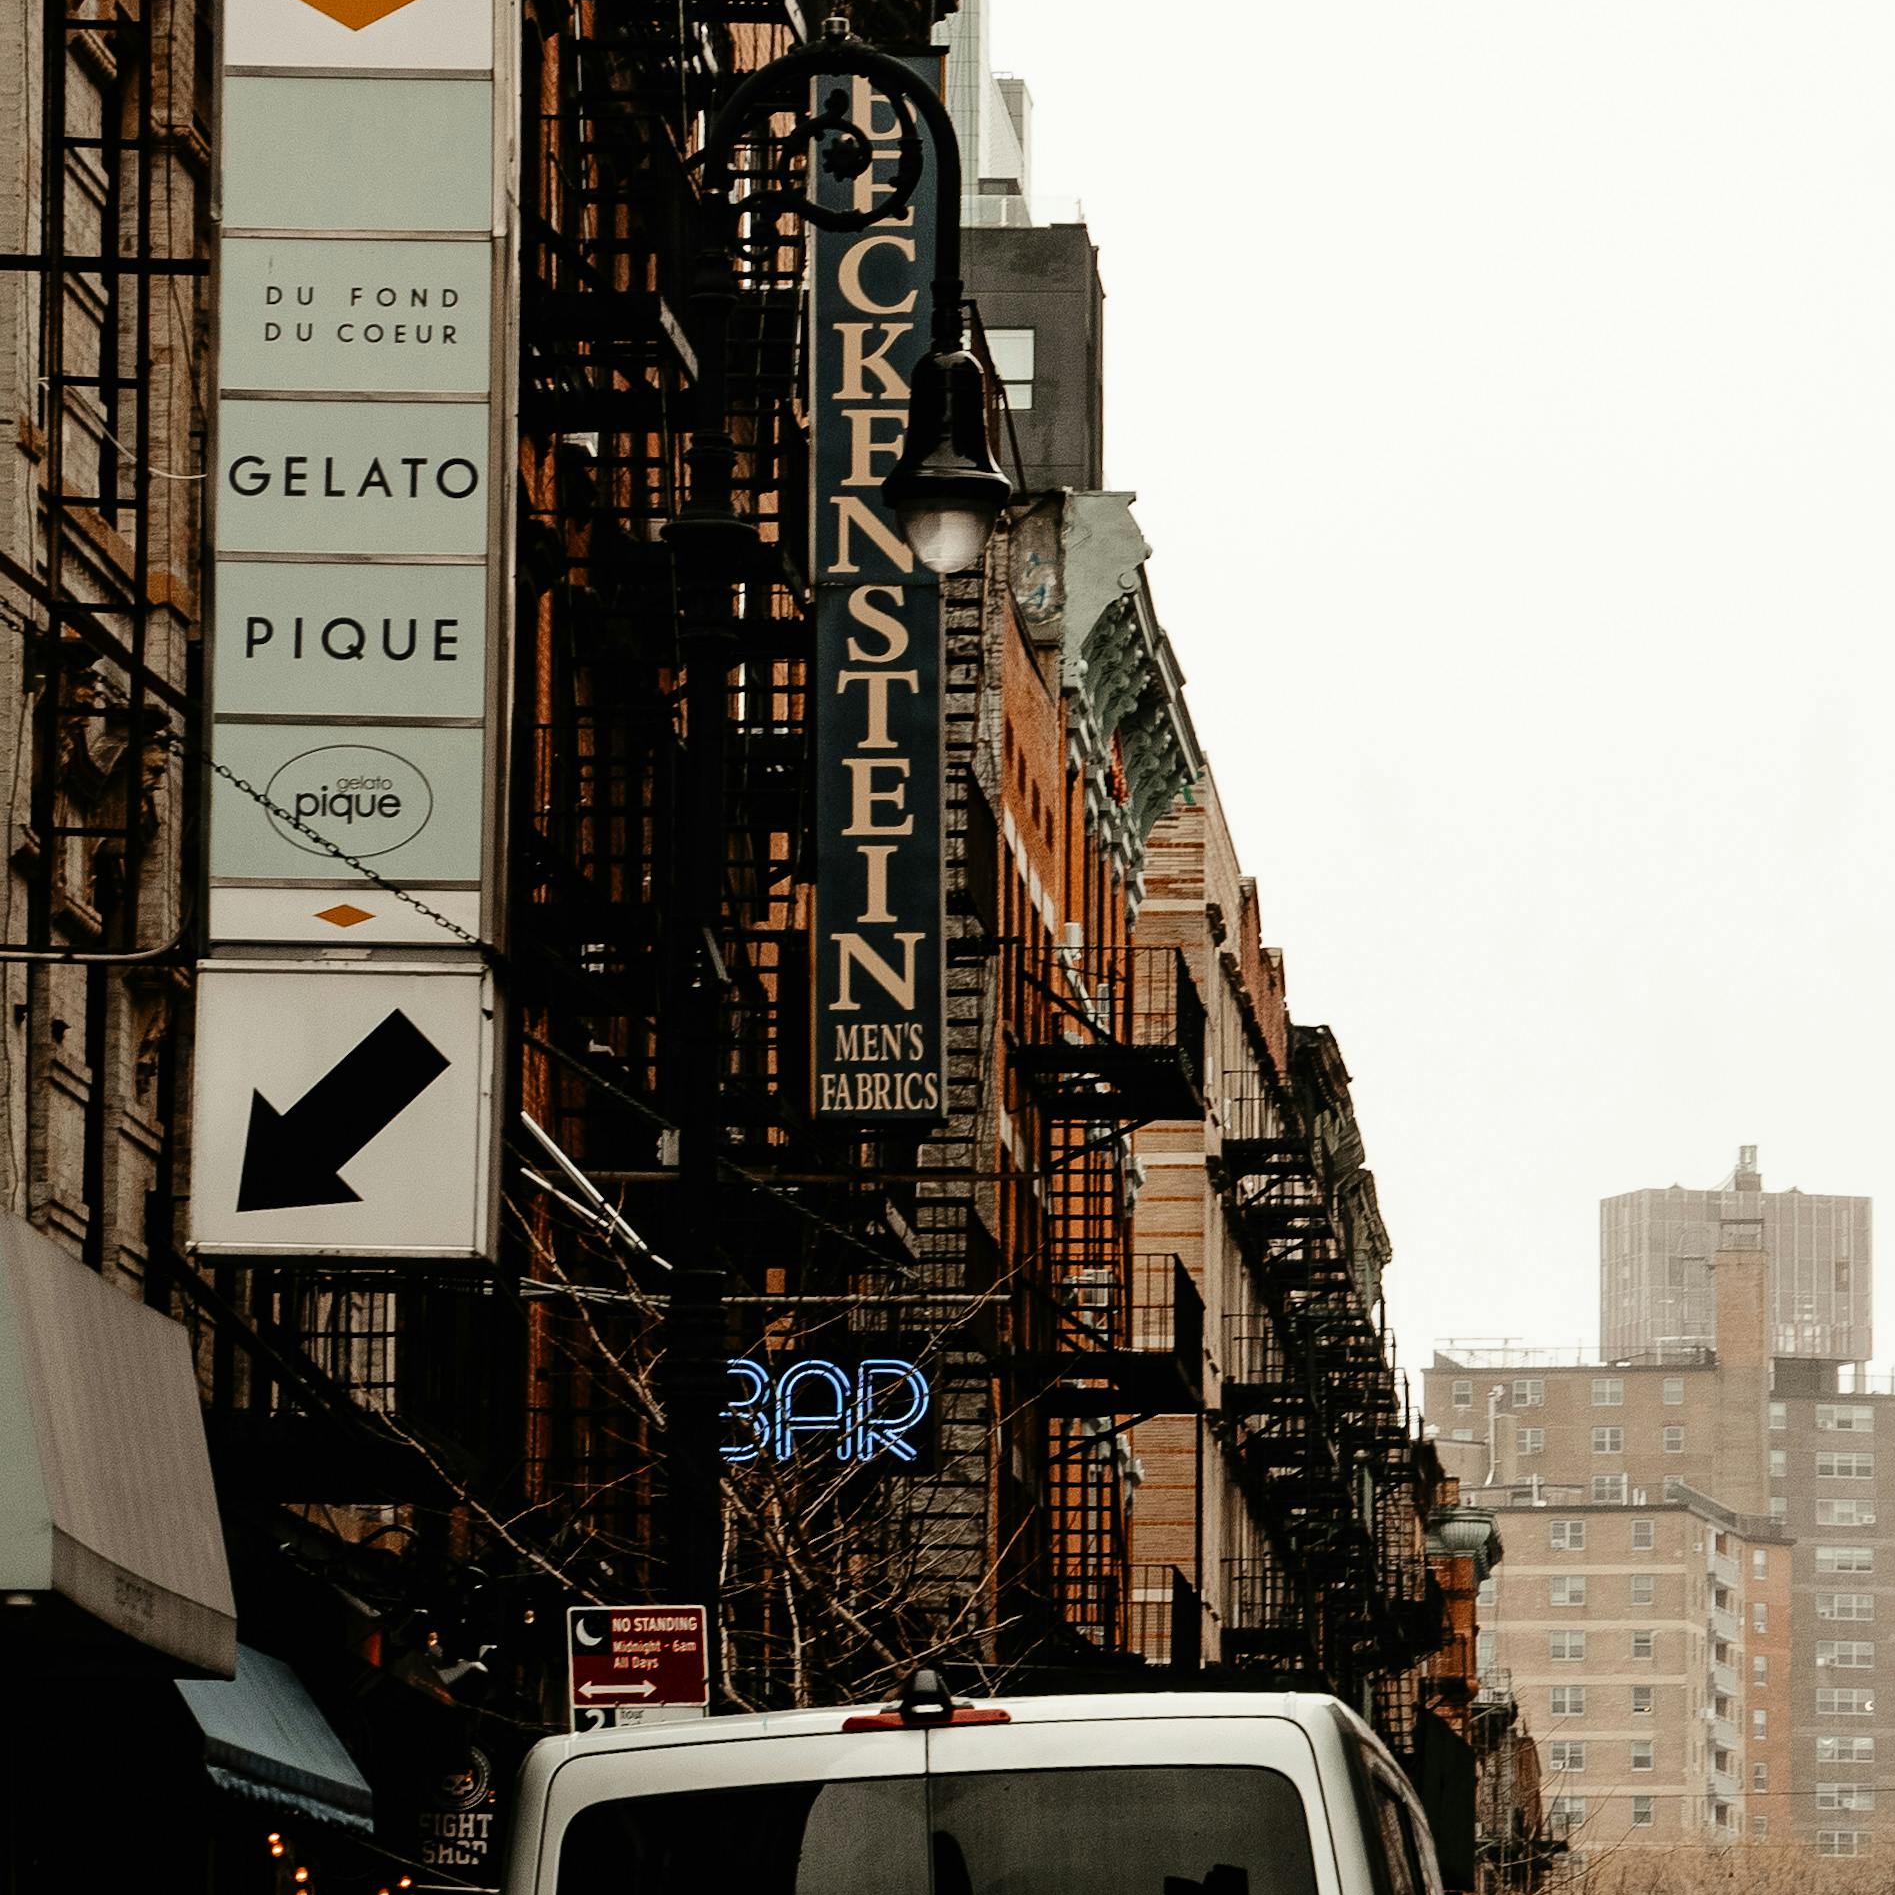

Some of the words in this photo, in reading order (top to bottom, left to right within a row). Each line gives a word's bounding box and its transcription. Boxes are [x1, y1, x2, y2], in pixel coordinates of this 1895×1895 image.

[264, 285, 319, 308] DU
[350, 285, 461, 308] FOND
[264, 321, 318, 344] DU
[336, 322, 460, 345] COEUR
[228, 454, 480, 500] GELATO
[244, 616, 460, 663] PIQUE
[337, 773, 394, 796] gelato
[294, 784, 402, 827] pique
[834, 1023, 925, 1064] MEN'S
[820, 1069, 940, 1114] FABRICS
[719, 1359, 930, 1462] BAR
[612, 1617, 632, 1632] NO
[633, 1616, 698, 1632] STANDING
[612, 1639, 661, 1655] Midnight
[672, 1639, 697, 1652] 6am
[613, 1656, 629, 1669] All
[631, 1656, 660, 1671] Days
[585, 1708, 606, 1732] 2
